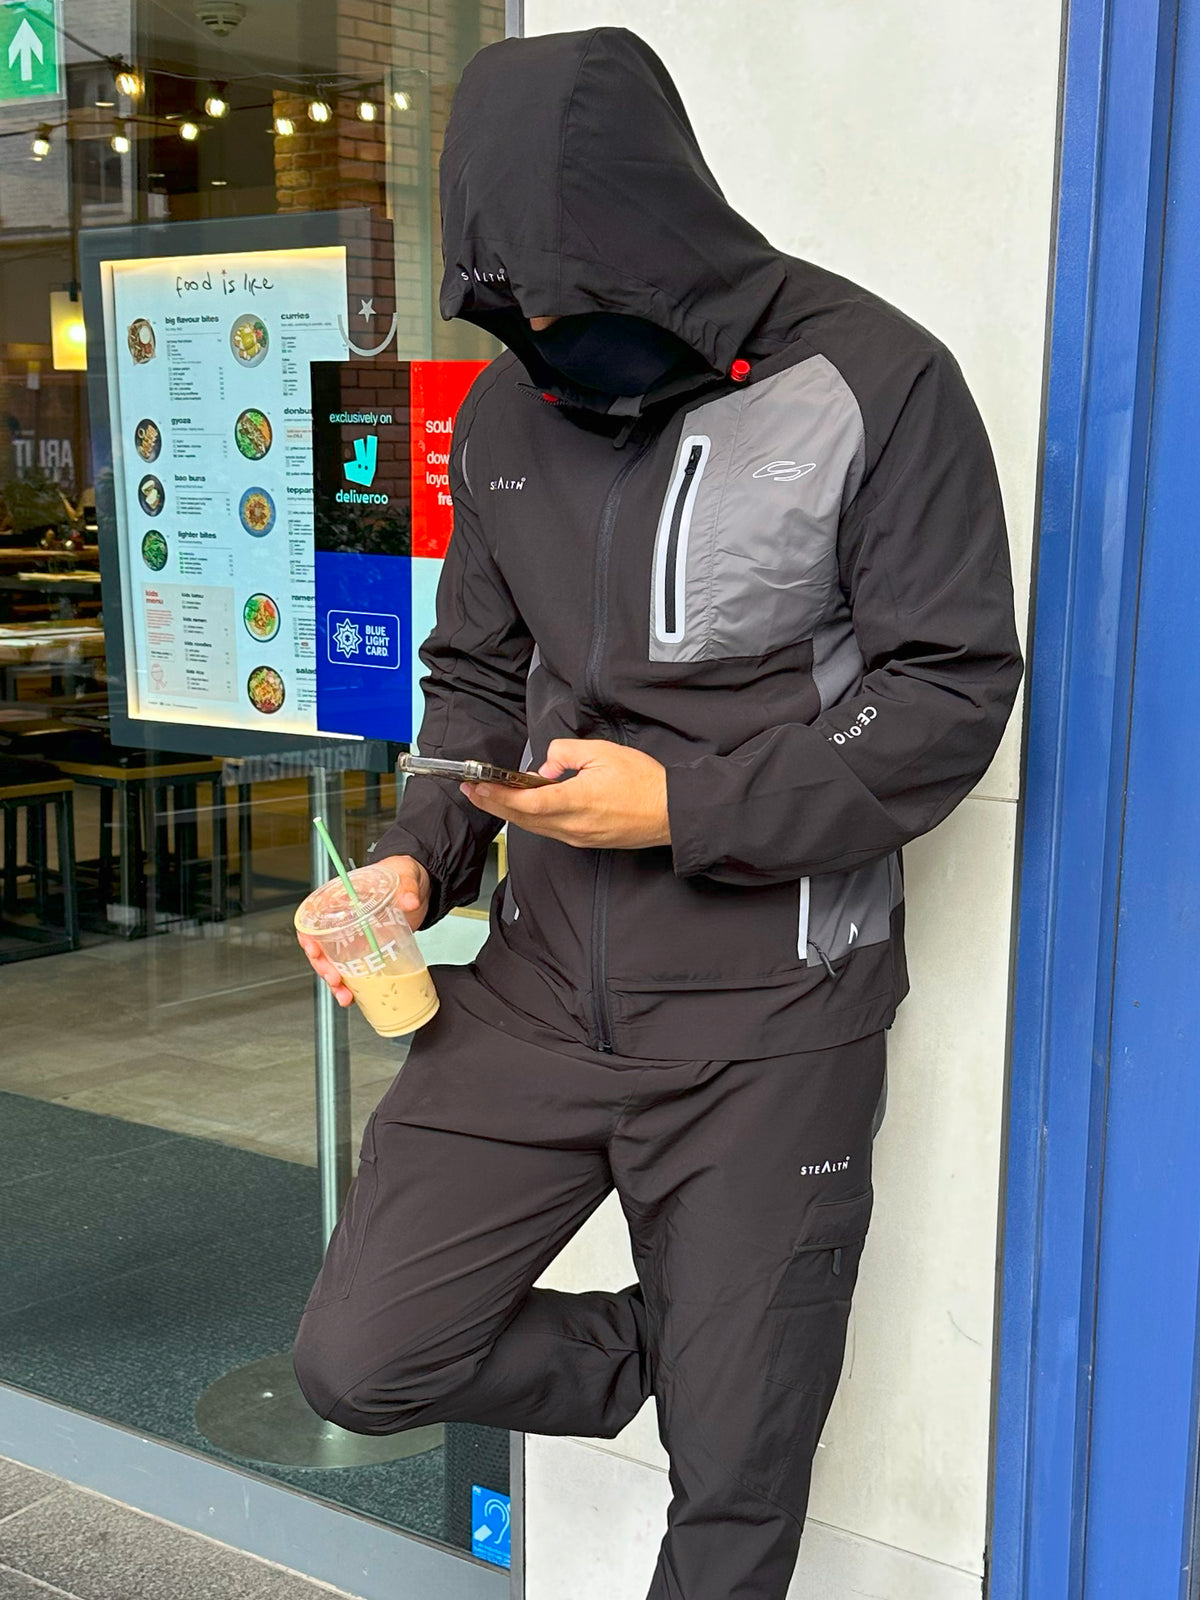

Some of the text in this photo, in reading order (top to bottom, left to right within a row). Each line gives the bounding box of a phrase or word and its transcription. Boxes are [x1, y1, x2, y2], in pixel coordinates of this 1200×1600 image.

[176, 271, 212, 298] food
[221, 269, 235, 296] is
[165, 317, 175, 325] big
[201, 315, 219, 323] bites
[280, 312, 310, 320] curries
[329, 411, 392, 426] exclusively on
[425, 417, 453, 434] soul
[335, 489, 389, 505] deliveroo
[178, 531, 198, 539] lighter
[365, 625, 386, 636] BLUE
[365, 635, 390, 647] LIGHT
[365, 646, 389, 657] CARD
